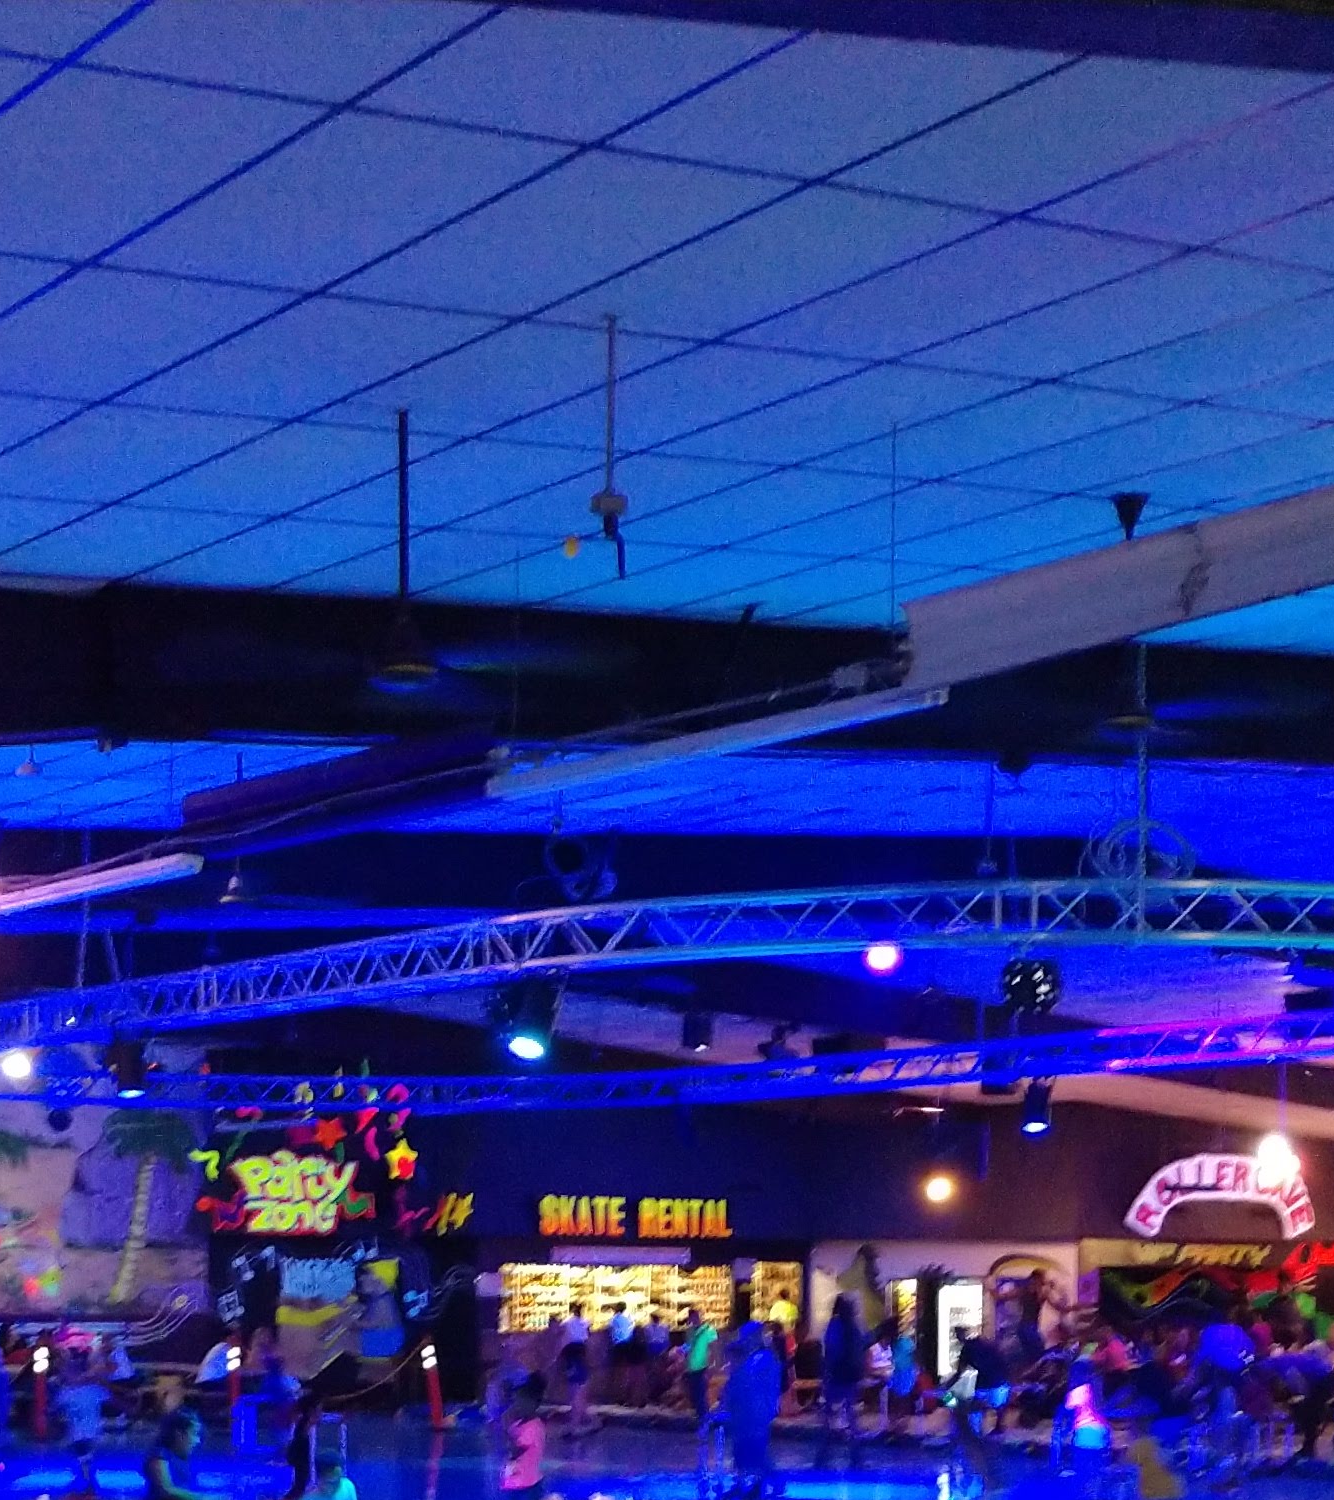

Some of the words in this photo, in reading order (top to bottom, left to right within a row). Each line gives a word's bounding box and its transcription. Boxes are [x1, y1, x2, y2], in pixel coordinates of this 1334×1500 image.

[539, 1194, 626, 1236] SKATE
[638, 1197, 733, 1239] RENTAL
[1135, 1160, 1250, 1227] ROLLER
